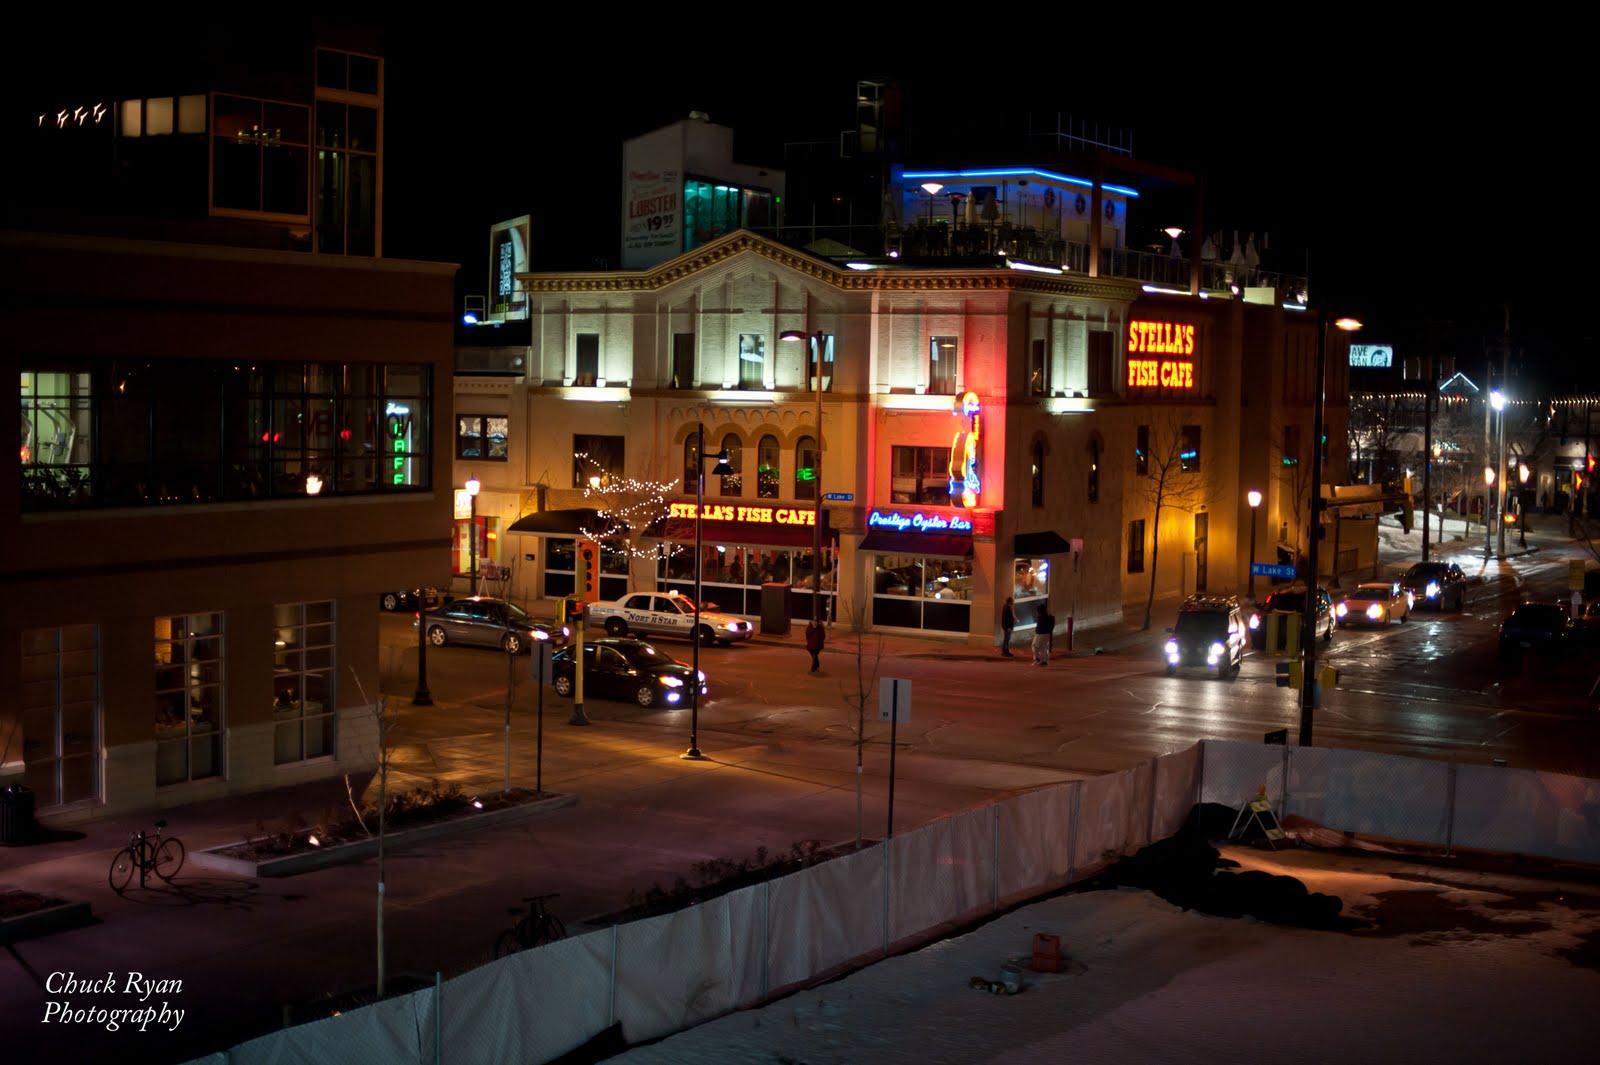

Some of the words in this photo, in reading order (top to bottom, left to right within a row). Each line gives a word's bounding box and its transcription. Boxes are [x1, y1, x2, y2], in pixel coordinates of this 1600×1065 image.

[629, 193, 677, 219] LOBSTER
[1128, 320, 1194, 355] STELLA'S
[1128, 360, 1158, 386] FISH
[1160, 361, 1193, 388] CAFE
[669, 502, 735, 521] STELA'S
[737, 506, 773, 523] FISH
[775, 509, 816, 526] CAFE
[869, 511, 911, 531] Prestige
[912, 513, 948, 532] Oyster
[949, 516, 972, 530] Bar
[1252, 566, 1259, 574] W
[1263, 566, 1282, 575] Lake
[1286, 567, 1295, 576] St
